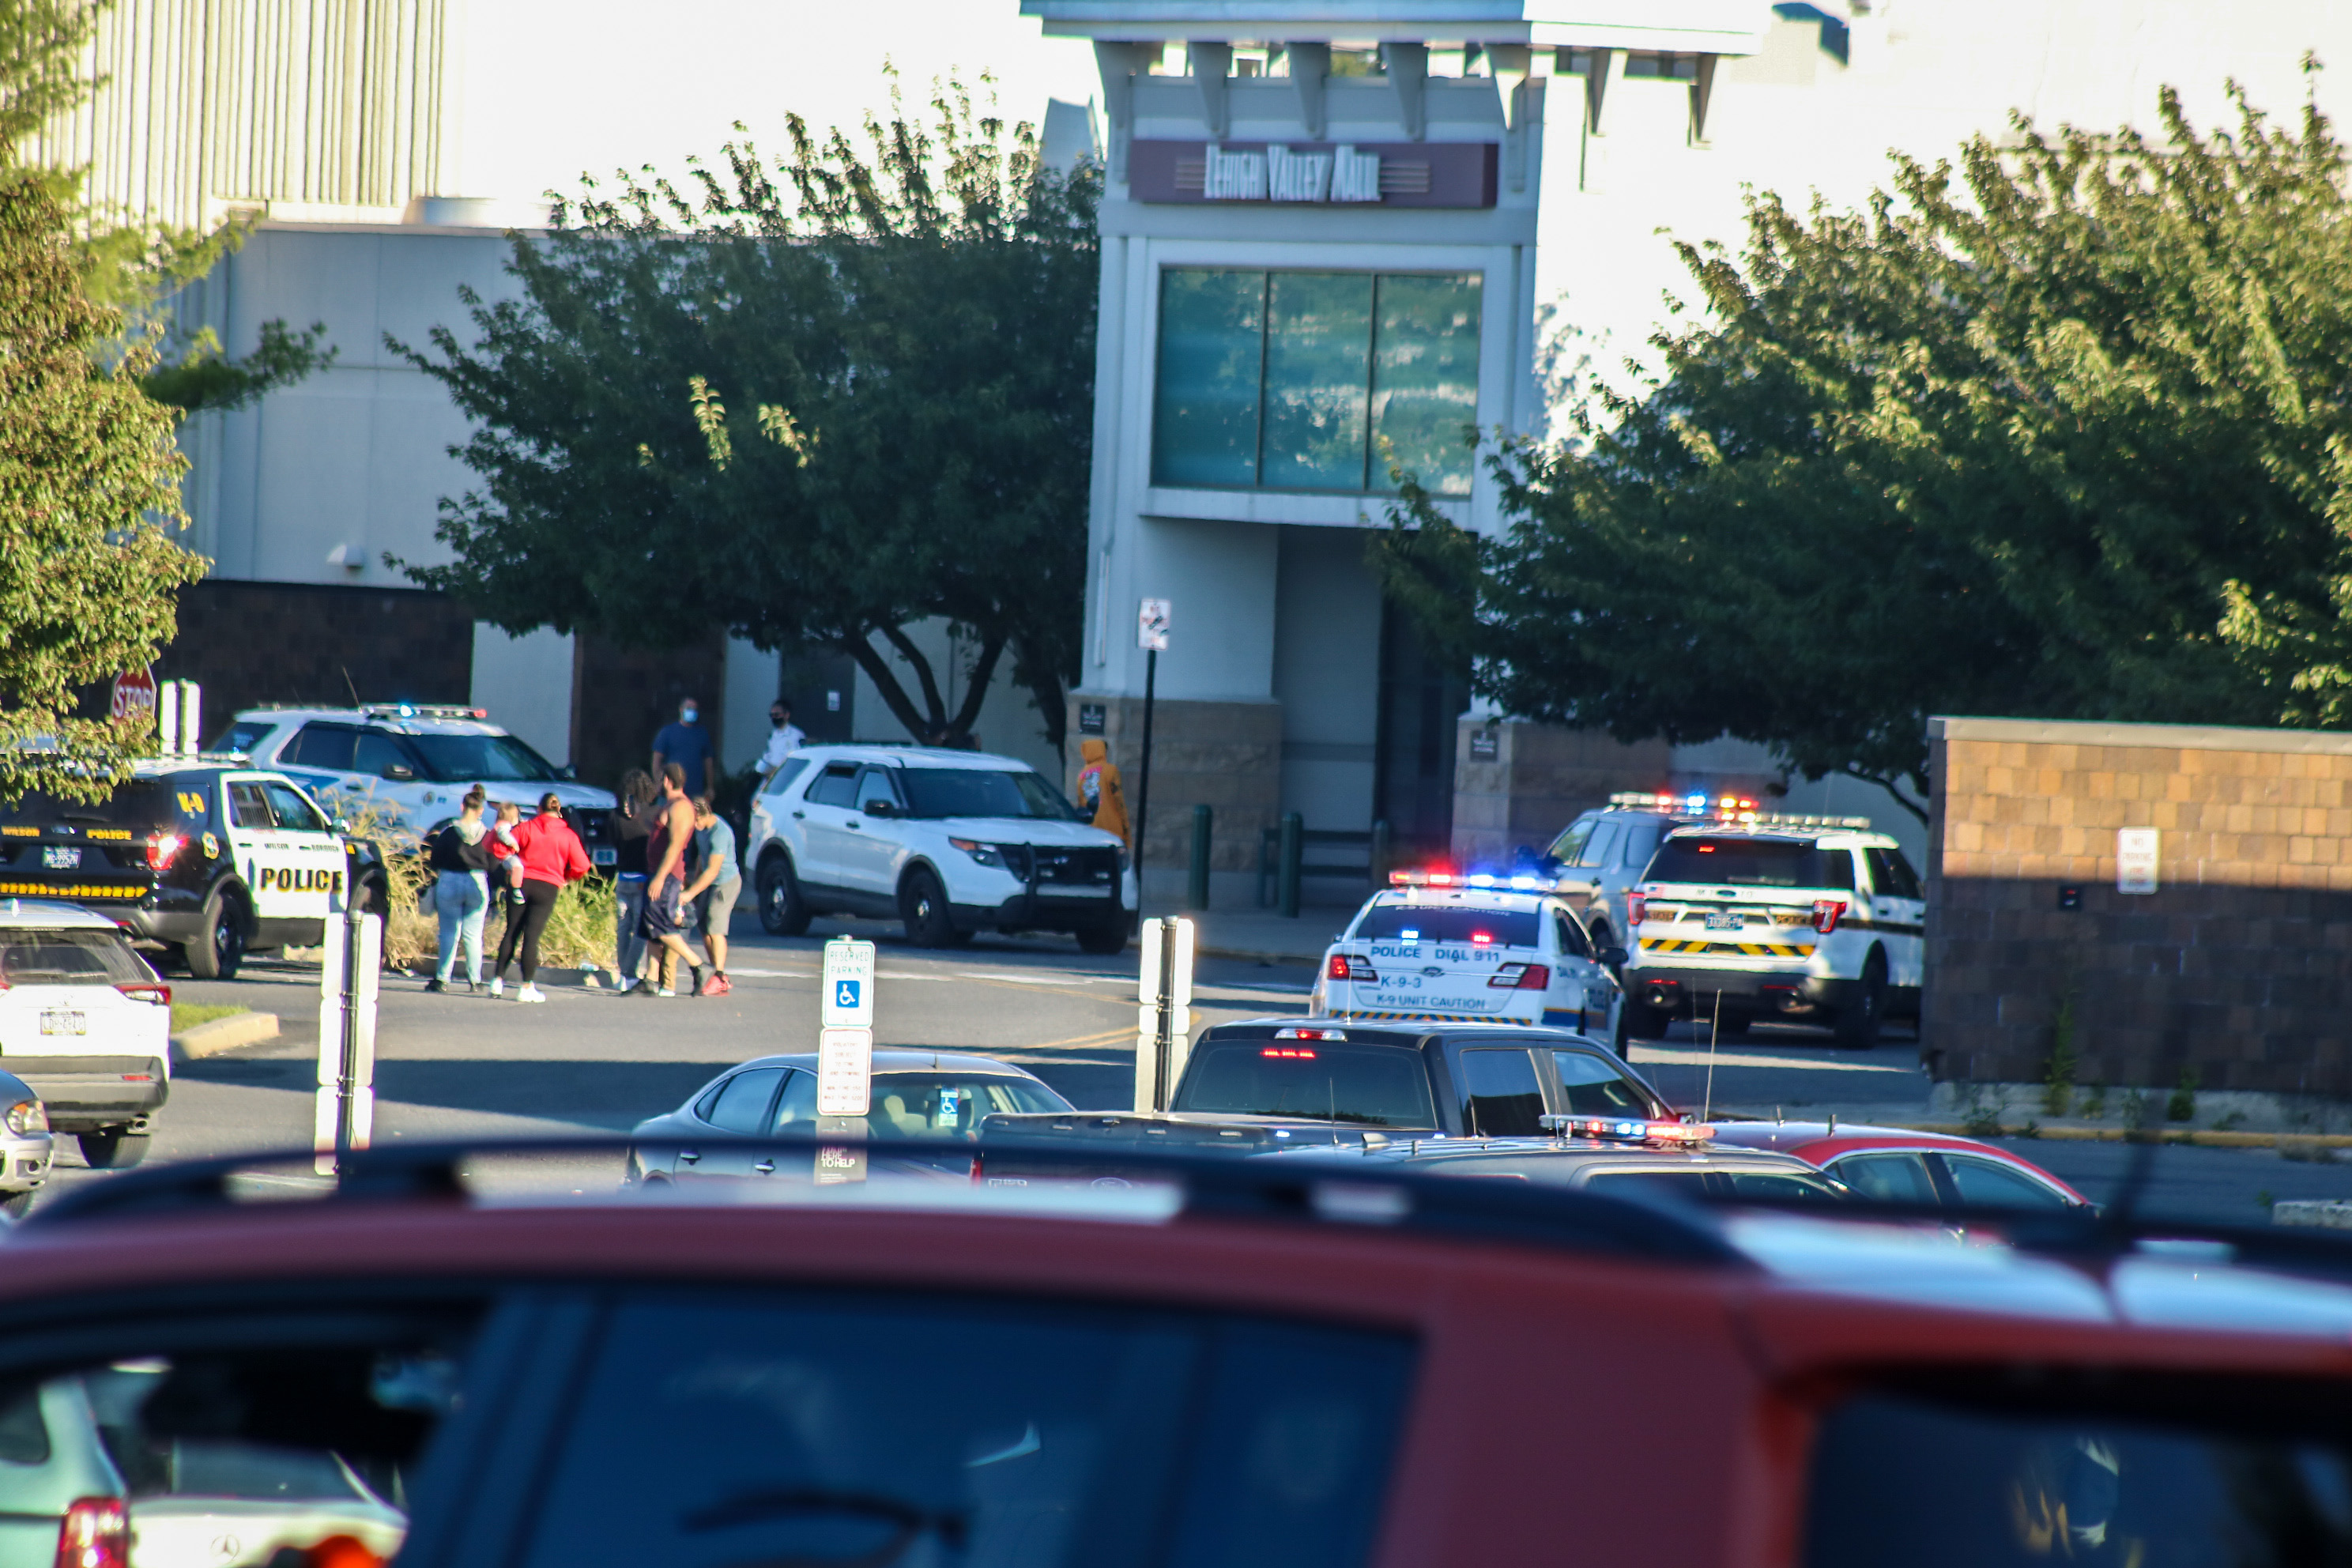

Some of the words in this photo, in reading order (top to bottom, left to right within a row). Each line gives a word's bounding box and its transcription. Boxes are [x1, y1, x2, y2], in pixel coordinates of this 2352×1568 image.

[114, 684, 153, 718] STOP
[2, 826, 40, 837] WILSON
[86, 829, 132, 840] POLICE
[260, 868, 343, 894] POLICE
[1649, 910, 1673, 921] STATE
[831, 951, 869, 962] RESERVED
[1371, 947, 1422, 958] POLICE
[1435, 949, 1468, 961] DIAL
[1474, 951, 1499, 962] 911
[831, 966, 868, 976] PARKING
[1381, 976, 1422, 988] K-9-3
[1377, 994, 1396, 1004] K-9
[1398, 995, 1427, 1006] UNIT
[1430, 997, 1486, 1010] CAUTION
[820, 1159, 834, 1168] TO
[835, 1159, 855, 1168] HELP
